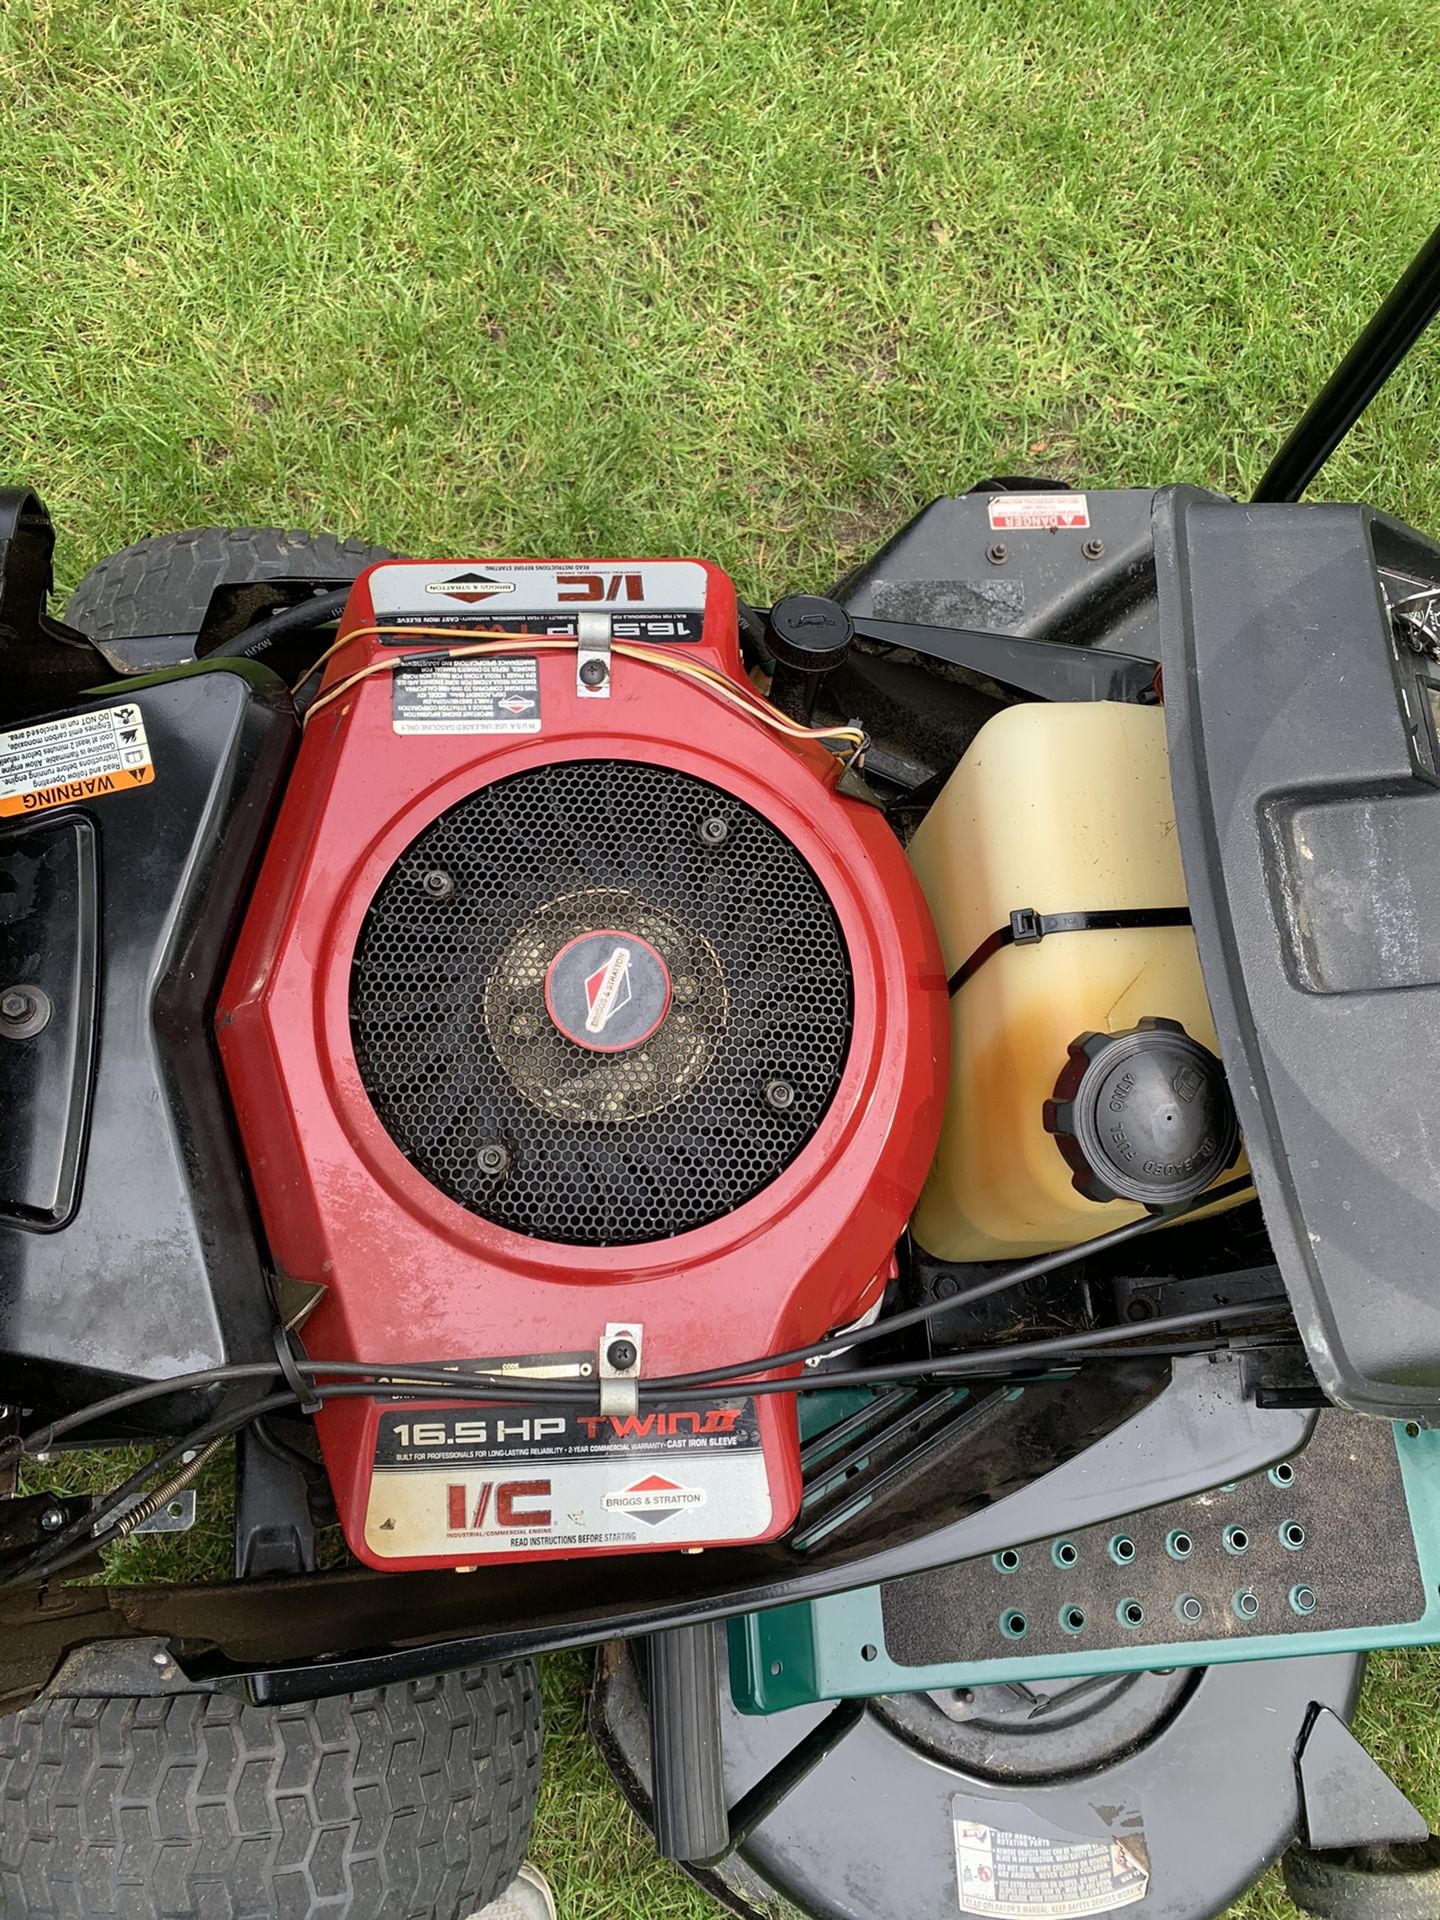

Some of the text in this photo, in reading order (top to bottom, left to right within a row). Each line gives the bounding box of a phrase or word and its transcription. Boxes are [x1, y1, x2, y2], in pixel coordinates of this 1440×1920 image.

[1005, 516, 1058, 527] DANGER
[556, 575, 645, 601] I/C
[547, 622, 691, 636] 16.5 P
[67, 719, 80, 727] run
[80, 715, 97, 725] NOT
[97, 712, 109, 721] DO
[7, 720, 111, 751] Engines emit carbon monoxide,
[7, 731, 25, 741] area.
[25, 723, 59, 738] enclosed
[98, 732, 114, 741] cool
[42, 743, 69, 755] minutes
[74, 738, 91, 747] least
[0, 741, 115, 773] Gasoline is flammable. Allow engine
[20, 749, 42, 760] before
[1, 752, 118, 785] Instructions before running engine.
[31, 761, 120, 789] Read and follow Operating
[22, 775, 115, 809] WARNING
[607, 952, 625, 991] STRATTON
[1109, 1072, 1137, 1113] ONLY
[1110, 1121, 1137, 1162] FUEL
[392, 1421, 487, 1446] 16.5
[497, 1417, 566, 1442] HP
[699, 1408, 741, 1433] II
[396, 1437, 737, 1461] BUILT FOR PROFESSIONALS FOR LONG-LASTING RELIABILITY 2-YEAR COMMERCIAL WARRANTY CAST IRON SLEEVE
[446, 1479, 552, 1531] I/C
[606, 1494, 701, 1508] BRIGGS & STRATTON
[446, 1527, 552, 1538] INDUSTRIAL/COMMERCIAL ENGINE
[510, 1532, 637, 1547] READ INSTRUCTIONS BEFORE STARTING
[964, 1898, 981, 1909] READ
[982, 1902, 1021, 1913] OPERATOR'S
[1051, 1903, 1067, 1913] KEEP
[1068, 1900, 1090, 1911] SAFETY
[1091, 1894, 1116, 1907] DEVICES
